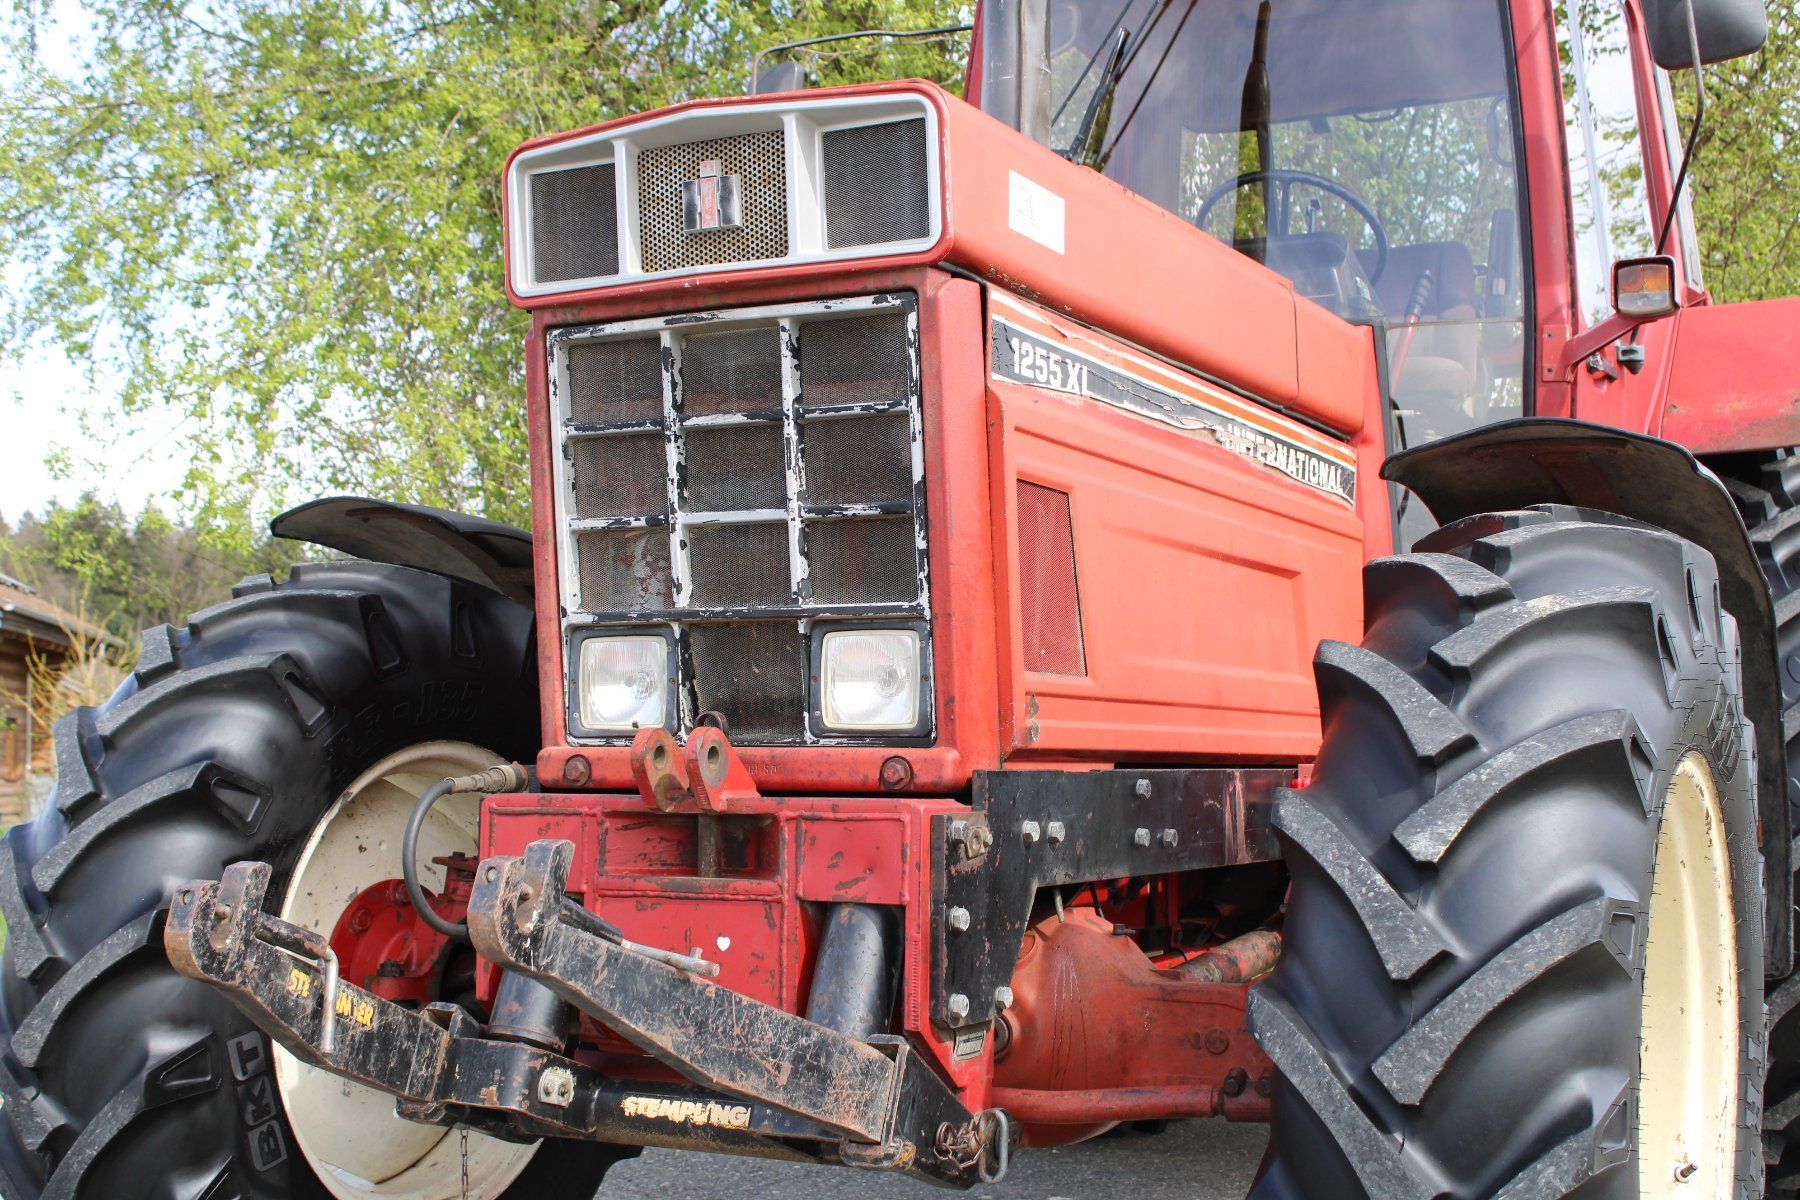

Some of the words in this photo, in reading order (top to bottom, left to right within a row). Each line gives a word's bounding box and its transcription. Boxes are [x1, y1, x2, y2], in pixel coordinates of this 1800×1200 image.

[1012, 337, 1061, 389] 1255
[1065, 358, 1093, 396] XL
[226, 1030, 288, 1172] BKT
